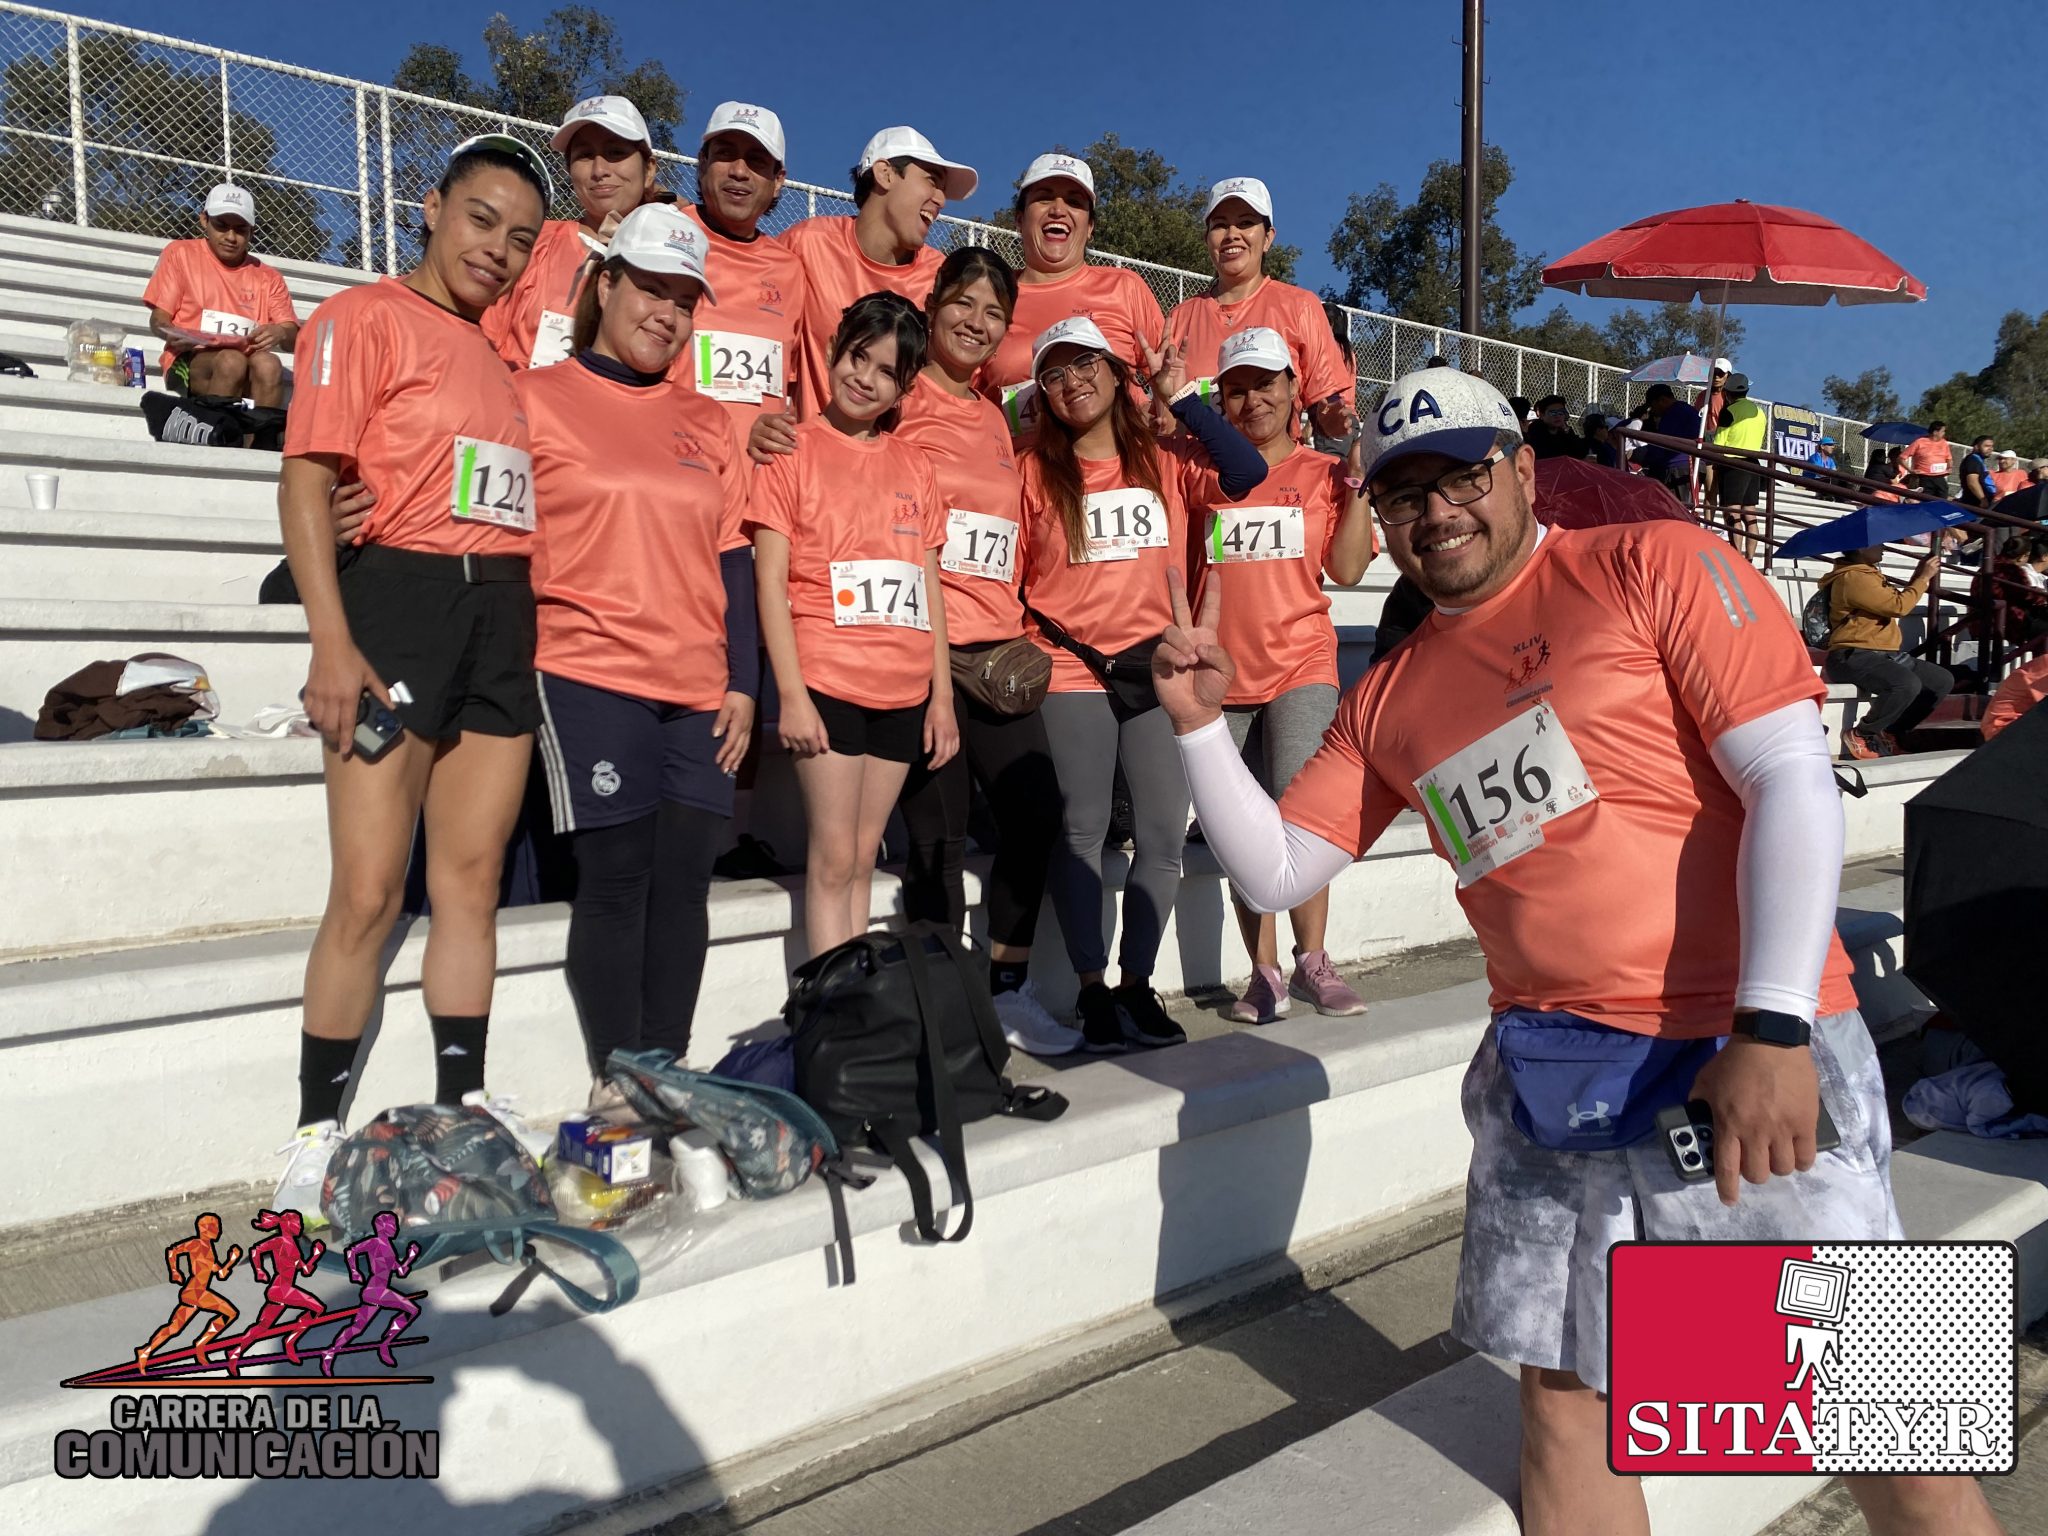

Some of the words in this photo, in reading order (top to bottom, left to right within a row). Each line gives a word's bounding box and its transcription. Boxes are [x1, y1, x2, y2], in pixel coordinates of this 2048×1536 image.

[713, 347, 773, 384] 234
[1378, 388, 1443, 436] CA
[473, 464, 527, 514] 122
[1088, 504, 1152, 539] 118
[1222, 519, 1287, 552] 471
[963, 528, 1009, 567] 173
[857, 578, 919, 616] 174
[1512, 633, 1543, 655] XLIV
[1449, 743, 1552, 839] 156
